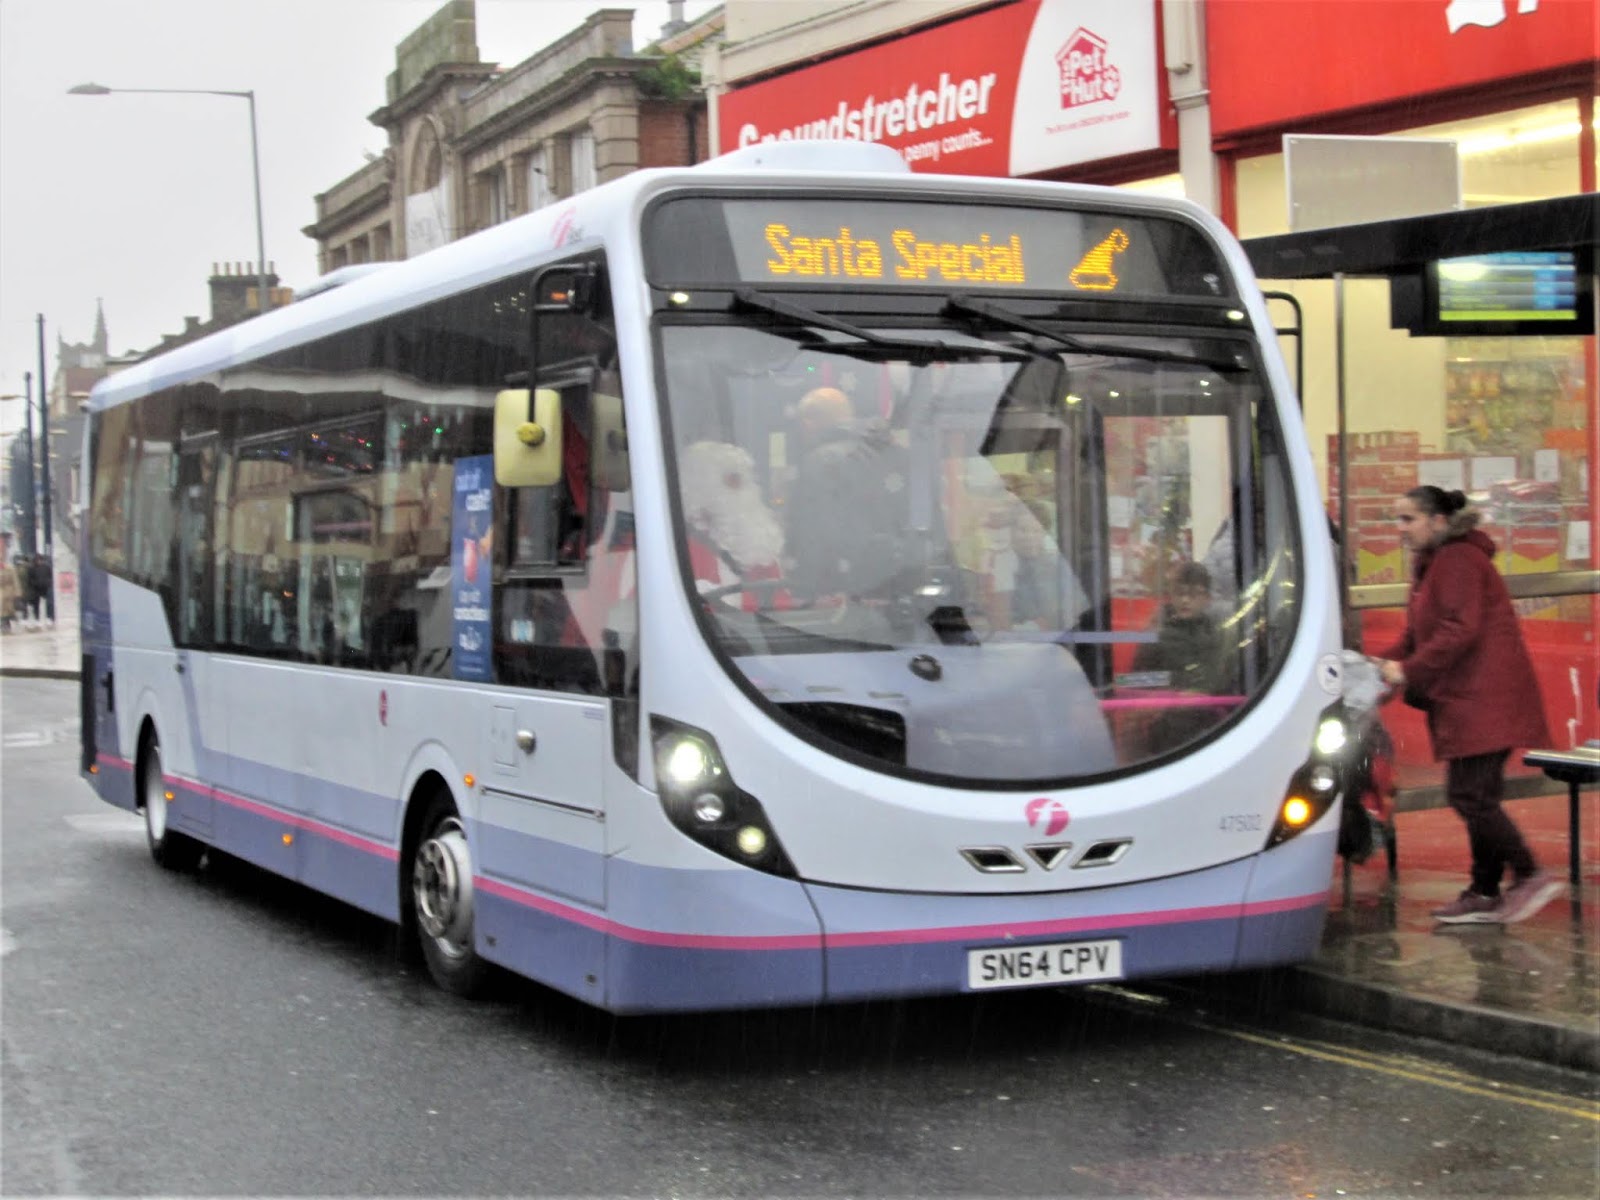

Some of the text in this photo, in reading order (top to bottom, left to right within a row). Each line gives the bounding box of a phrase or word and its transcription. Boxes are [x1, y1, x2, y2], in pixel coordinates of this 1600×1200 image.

[1069, 47, 1101, 77] Pet
[1070, 74, 1102, 105] Hut
[904, 139, 940, 162] penny
[765, 223, 1025, 283] Santa Special
[981, 945, 1110, 981] SN64 CPV
